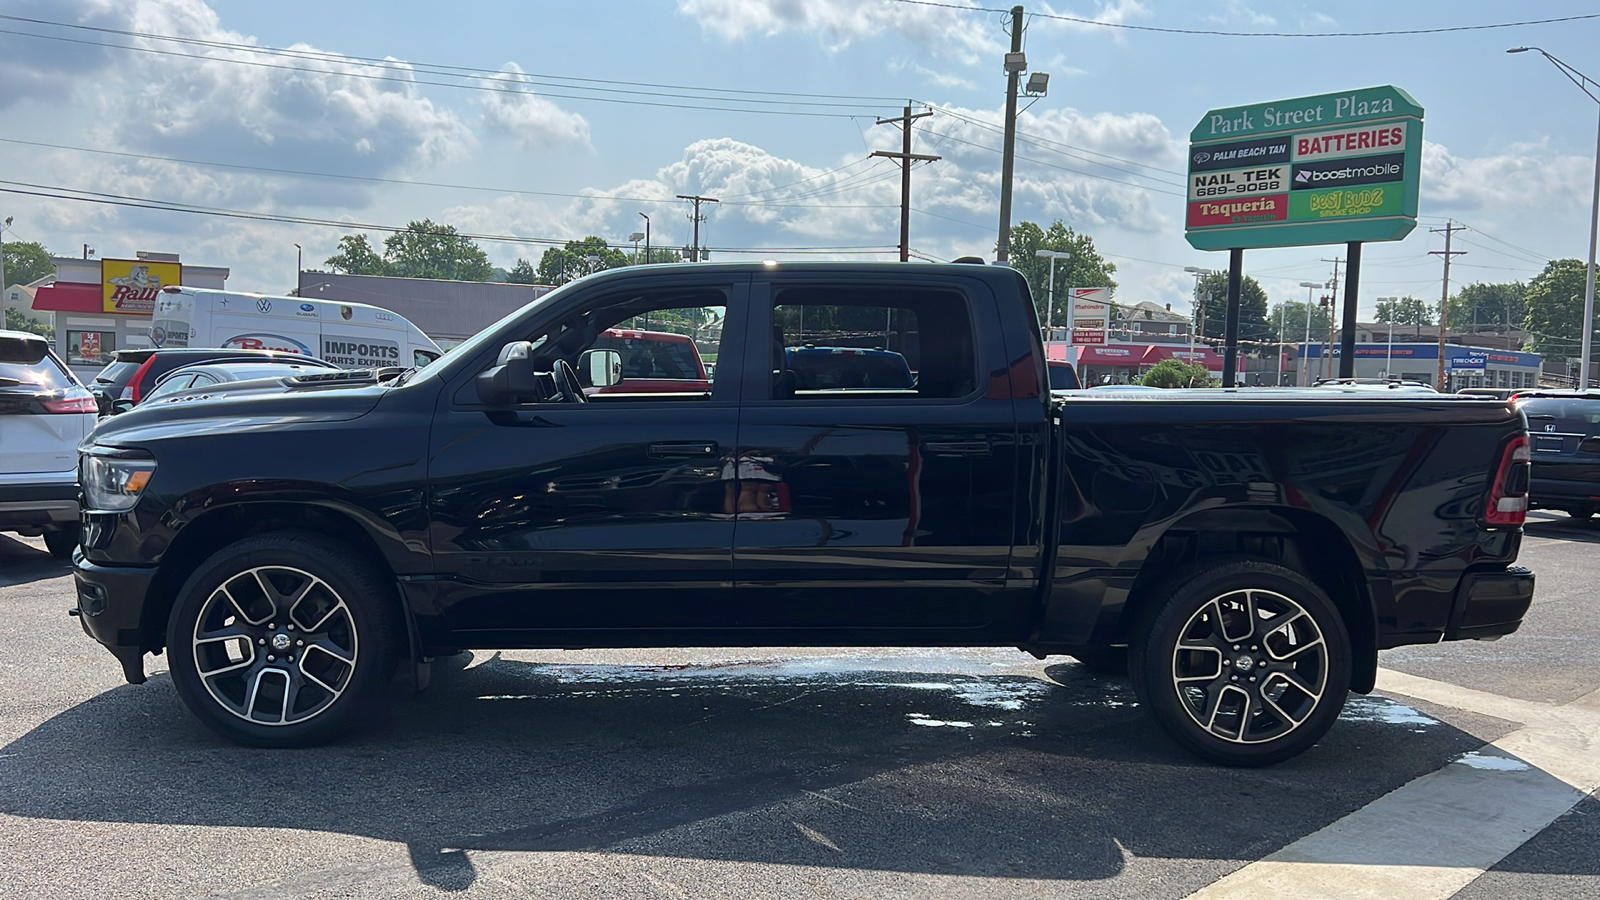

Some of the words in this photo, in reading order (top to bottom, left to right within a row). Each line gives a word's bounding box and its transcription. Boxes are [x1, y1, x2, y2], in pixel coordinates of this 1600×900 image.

[1210, 110, 1254, 134] Park
[1263, 105, 1323, 128] Street
[1334, 95, 1394, 119] Plaza
[1297, 127, 1403, 155] BATTERIES
[1213, 152, 1237, 161] PALM
[1237, 146, 1267, 158] BEACH
[1268, 144, 1287, 154] TAN
[1195, 173, 1235, 187] NAIL
[1243, 168, 1282, 182] TEK
[1196, 181, 1280, 197] 689-9088
[1344, 188, 1384, 208] BUDZ
[1200, 198, 1276, 217] Taquería
[1320, 208, 1347, 217] SMOKE
[1348, 207, 1371, 216] SHOP
[325, 341, 399, 359] IMPORTS
[325, 355, 355, 366] PARTS
[357, 357, 398, 367] EXPRESS
